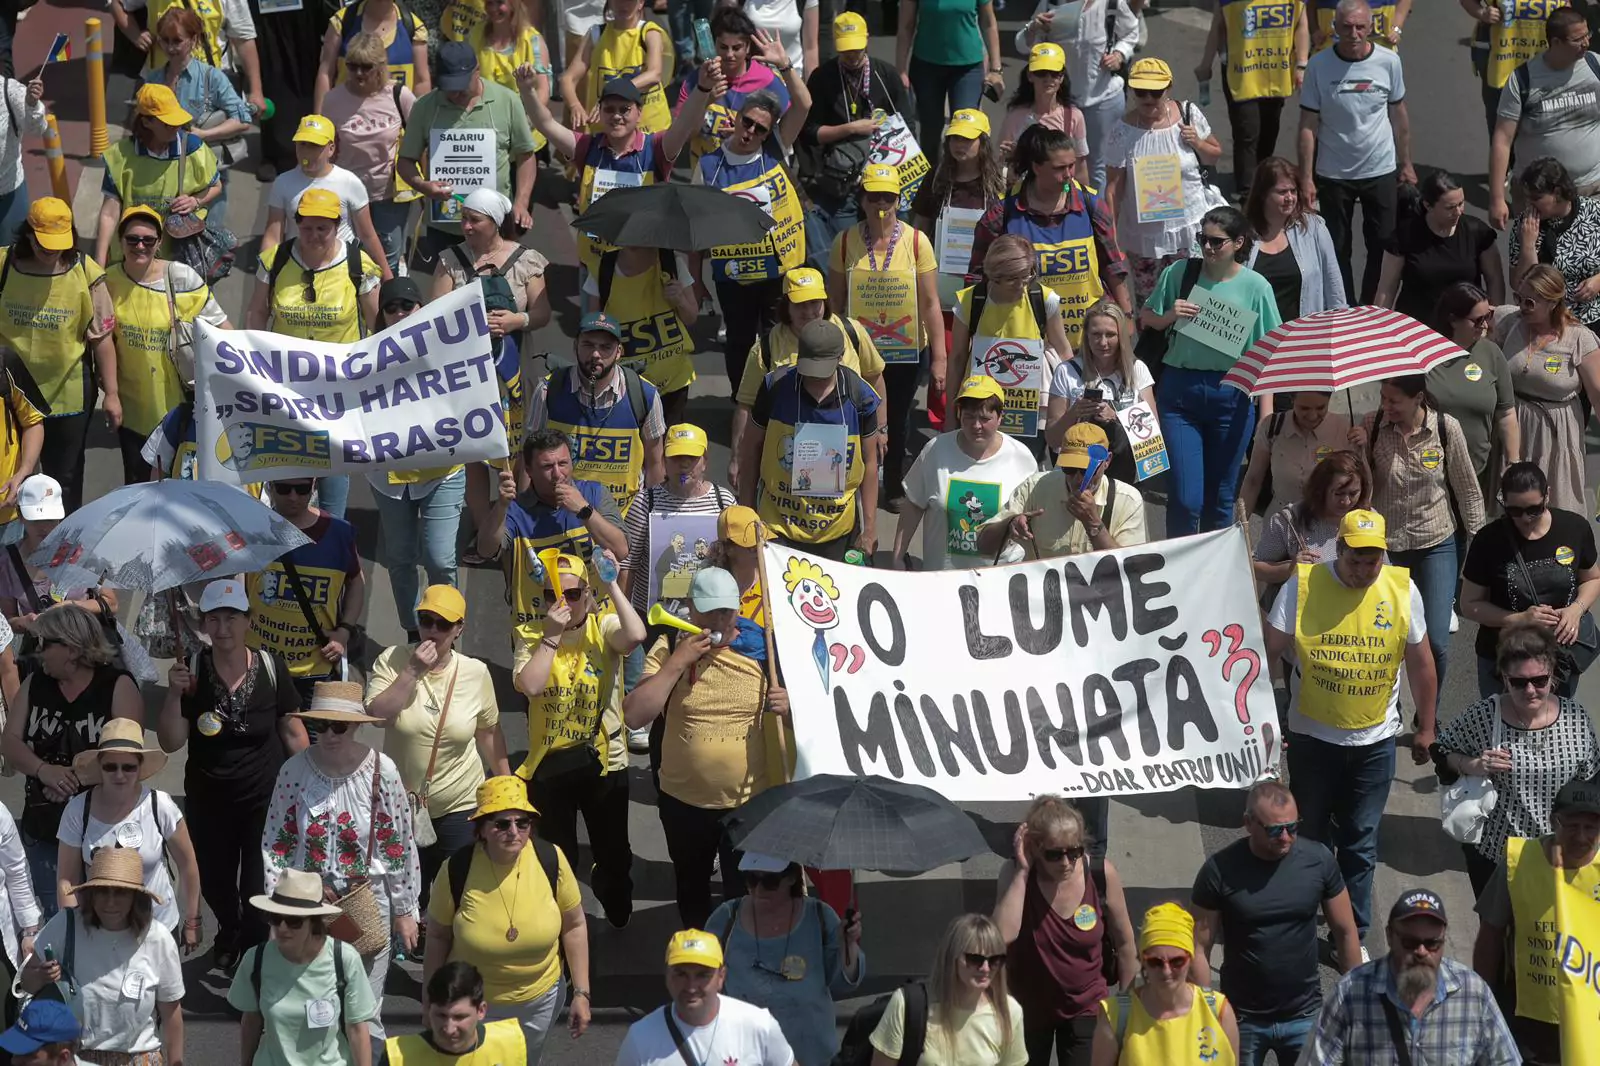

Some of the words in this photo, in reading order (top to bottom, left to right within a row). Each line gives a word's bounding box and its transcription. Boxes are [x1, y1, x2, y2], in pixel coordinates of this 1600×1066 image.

[1256, 6, 1292, 27] FSE
[440, 133, 485, 142] SALARIU
[453, 144, 475, 152] BUN
[435, 166, 490, 175] PROFESOR
[711, 245, 773, 257] SALARIILE
[739, 259, 767, 272] FSE
[1040, 247, 1088, 273] FSE
[280, 311, 306, 319] SPIRU
[1207, 297, 1226, 311] NOI
[1227, 307, 1242, 319] NU
[36, 314, 68, 323] HARET
[1233, 323, 1246, 334] CI
[215, 303, 490, 383] SINDICATUL
[359, 354, 494, 414] HARET
[1003, 400, 1038, 409] RIILE!
[255, 427, 329, 456] FSE
[579, 438, 630, 460] FSE
[578, 460, 602, 470] Spiru
[958, 552, 1179, 660] LUME
[1321, 633, 1385, 649] FEDERAȚIA
[1310, 649, 1392, 664] SINDICATELOR
[1142, 756, 1214, 790] PENTRU
[1529, 954, 1548, 970] DIN
